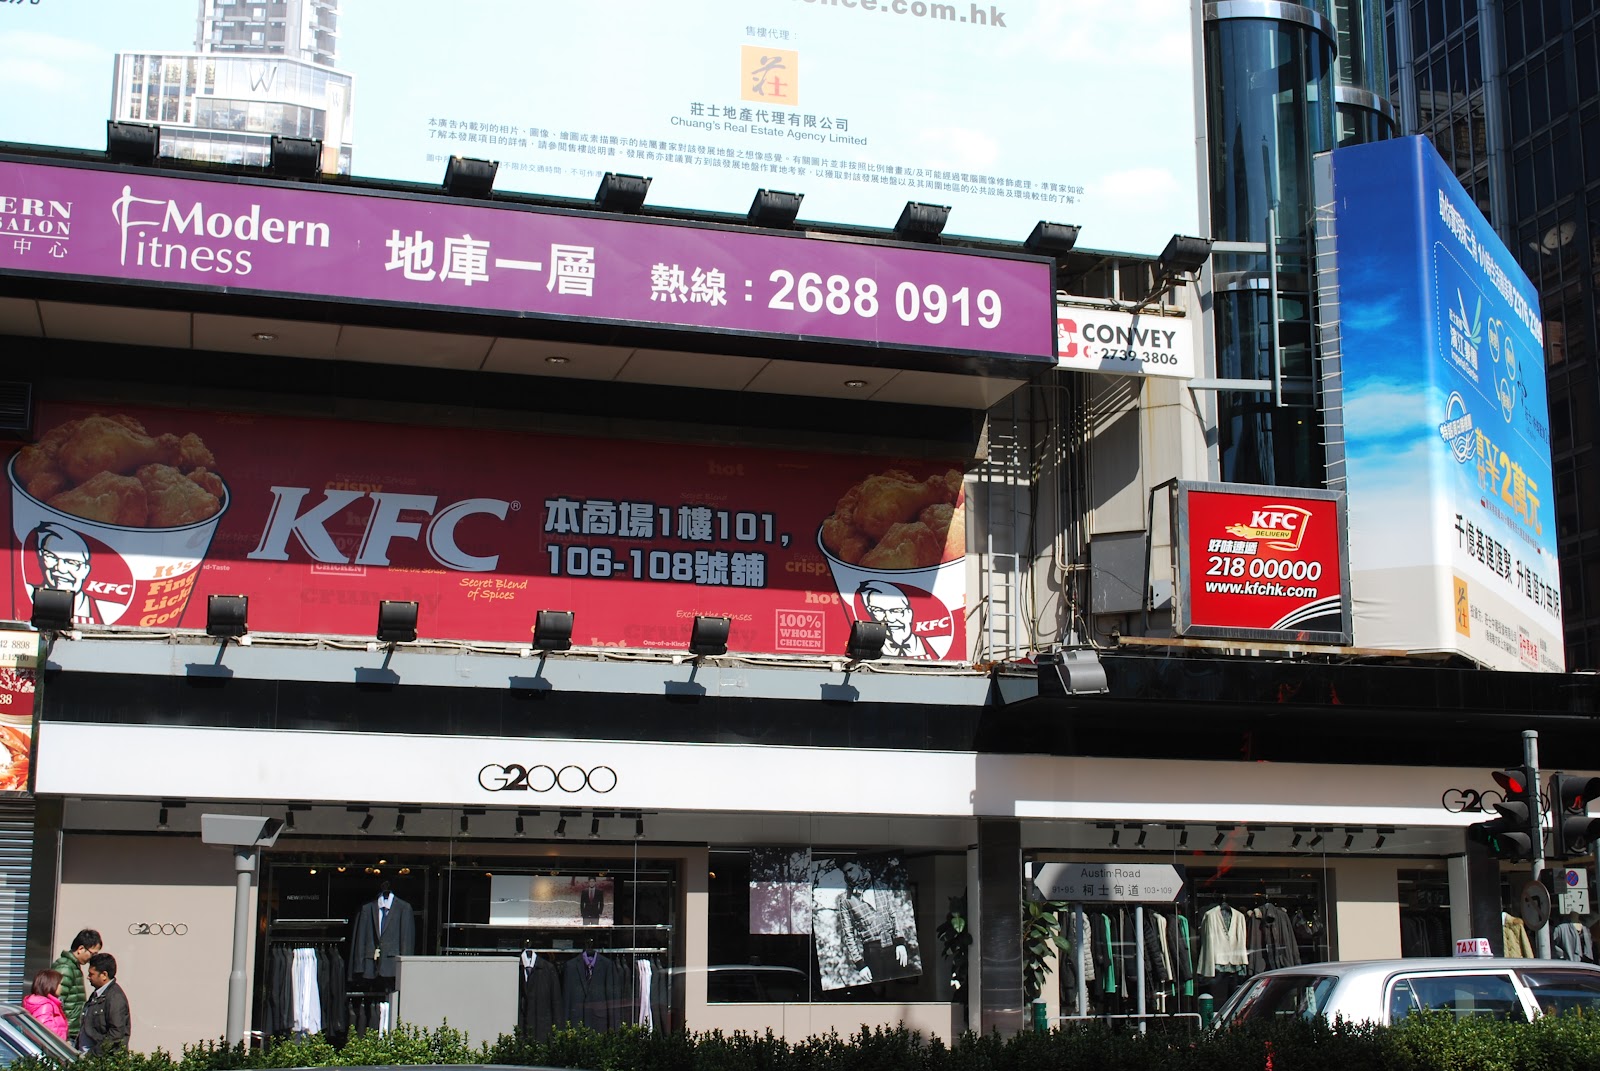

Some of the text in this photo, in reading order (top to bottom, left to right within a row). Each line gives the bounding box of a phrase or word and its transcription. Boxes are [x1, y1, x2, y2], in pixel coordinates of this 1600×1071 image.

[690, 102, 849, 132] 莊士地產代理有限公司
[670, 116, 867, 146] Chuang's Real Estate Agency Limited
[112, 185, 252, 275] Fitness
[161, 199, 330, 248] Modern
[384, 228, 596, 297] 地庫一層
[767, 269, 879, 318] 2688
[895, 281, 1002, 329] 0919
[1082, 323, 1176, 349] CONVEY
[1101, 347, 1178, 365] 2739 3806
[247, 485, 511, 573] KFC
[1250, 510, 1299, 530] KFC
[1255, 530, 1290, 538] DELIVERY
[785, 560, 831, 576] crisp
[1205, 556, 1322, 582] 218 00000
[86, 579, 133, 597] KFC
[459, 577, 528, 590] Secret Blend
[1205, 581, 1318, 598] www.kfchk.com
[466, 588, 515, 602] of Spices
[805, 590, 840, 605] hot
[779, 613, 822, 628] 100%
[915, 615, 951, 633] KFC
[780, 628, 822, 639] WHOLE
[779, 638, 821, 648] CHICKEN
[478, 763, 618, 794] G2000
[1080, 868, 1141, 878] Austin Road
[1082, 884, 1140, 897] 柯士甸道
[1143, 886, 1173, 894] 103-109
[128, 922, 189, 936] G2000
[1456, 940, 1477, 954] TAXI
